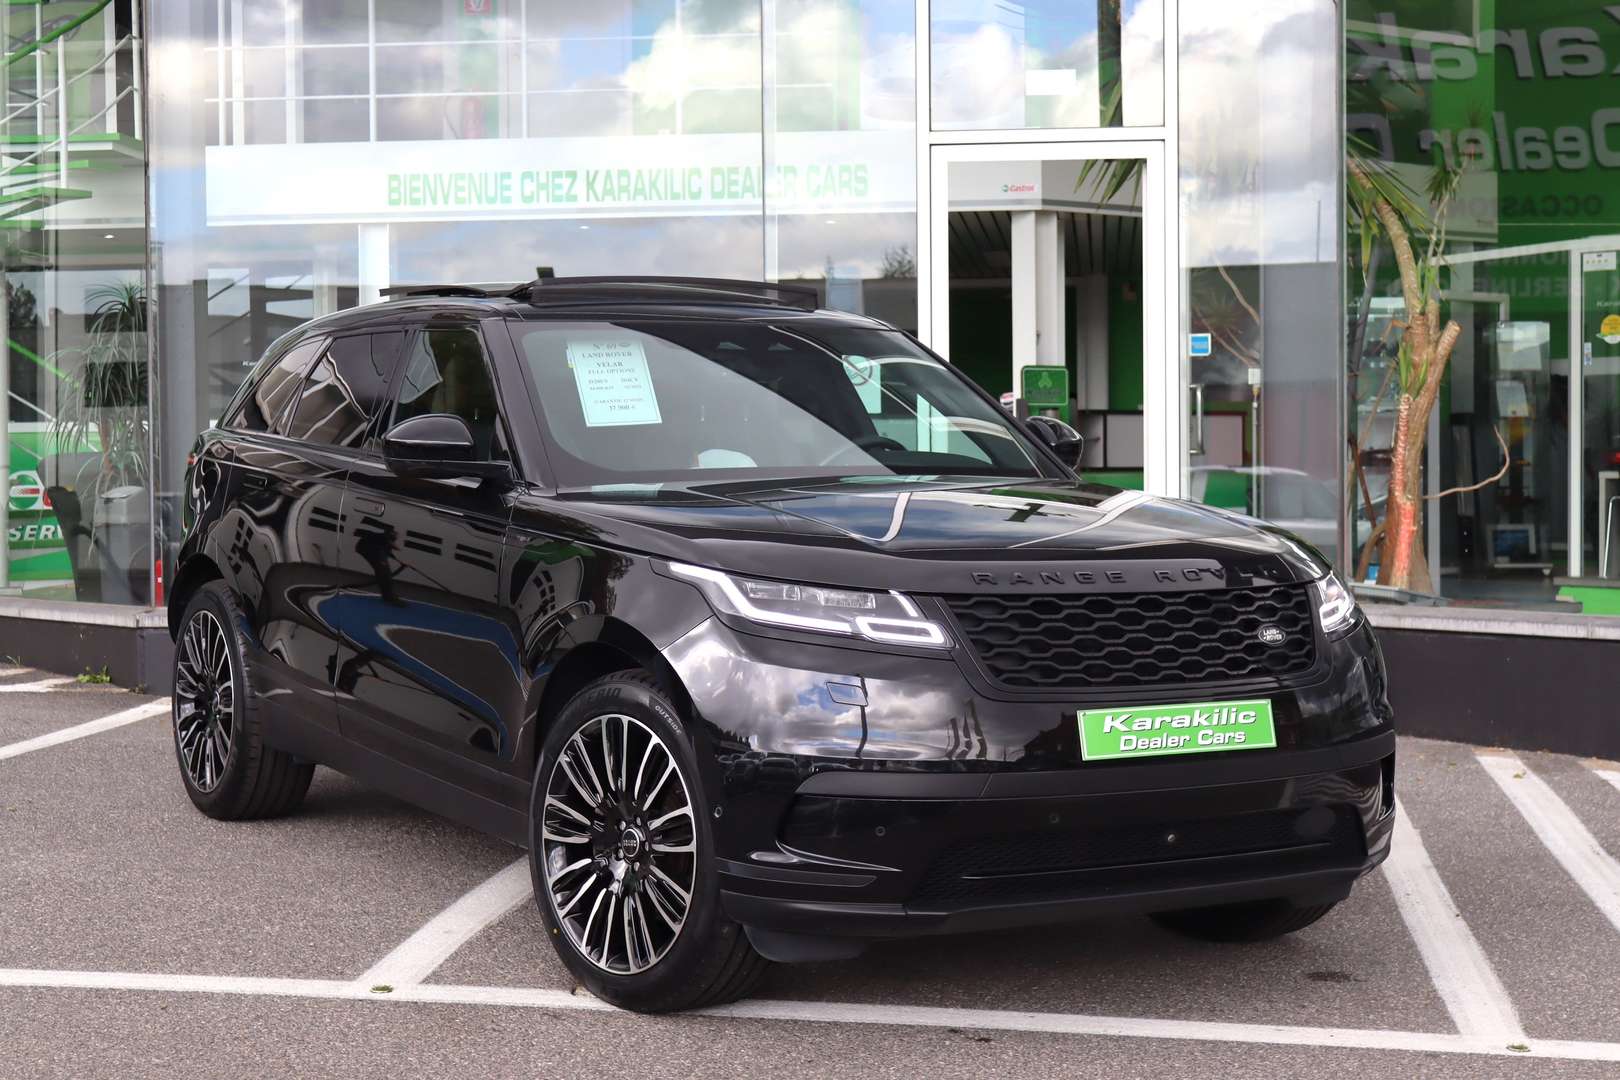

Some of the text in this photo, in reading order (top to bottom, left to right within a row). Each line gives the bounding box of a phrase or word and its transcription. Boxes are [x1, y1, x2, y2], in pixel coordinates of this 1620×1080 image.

[387, 163, 869, 206] BIENVENUE CHEZ KARAKILIC DEALR CARS
[971, 570, 1127, 586] RANGE
[1103, 706, 1257, 733] Karakilic
[1119, 729, 1246, 752] Dealer Cars
